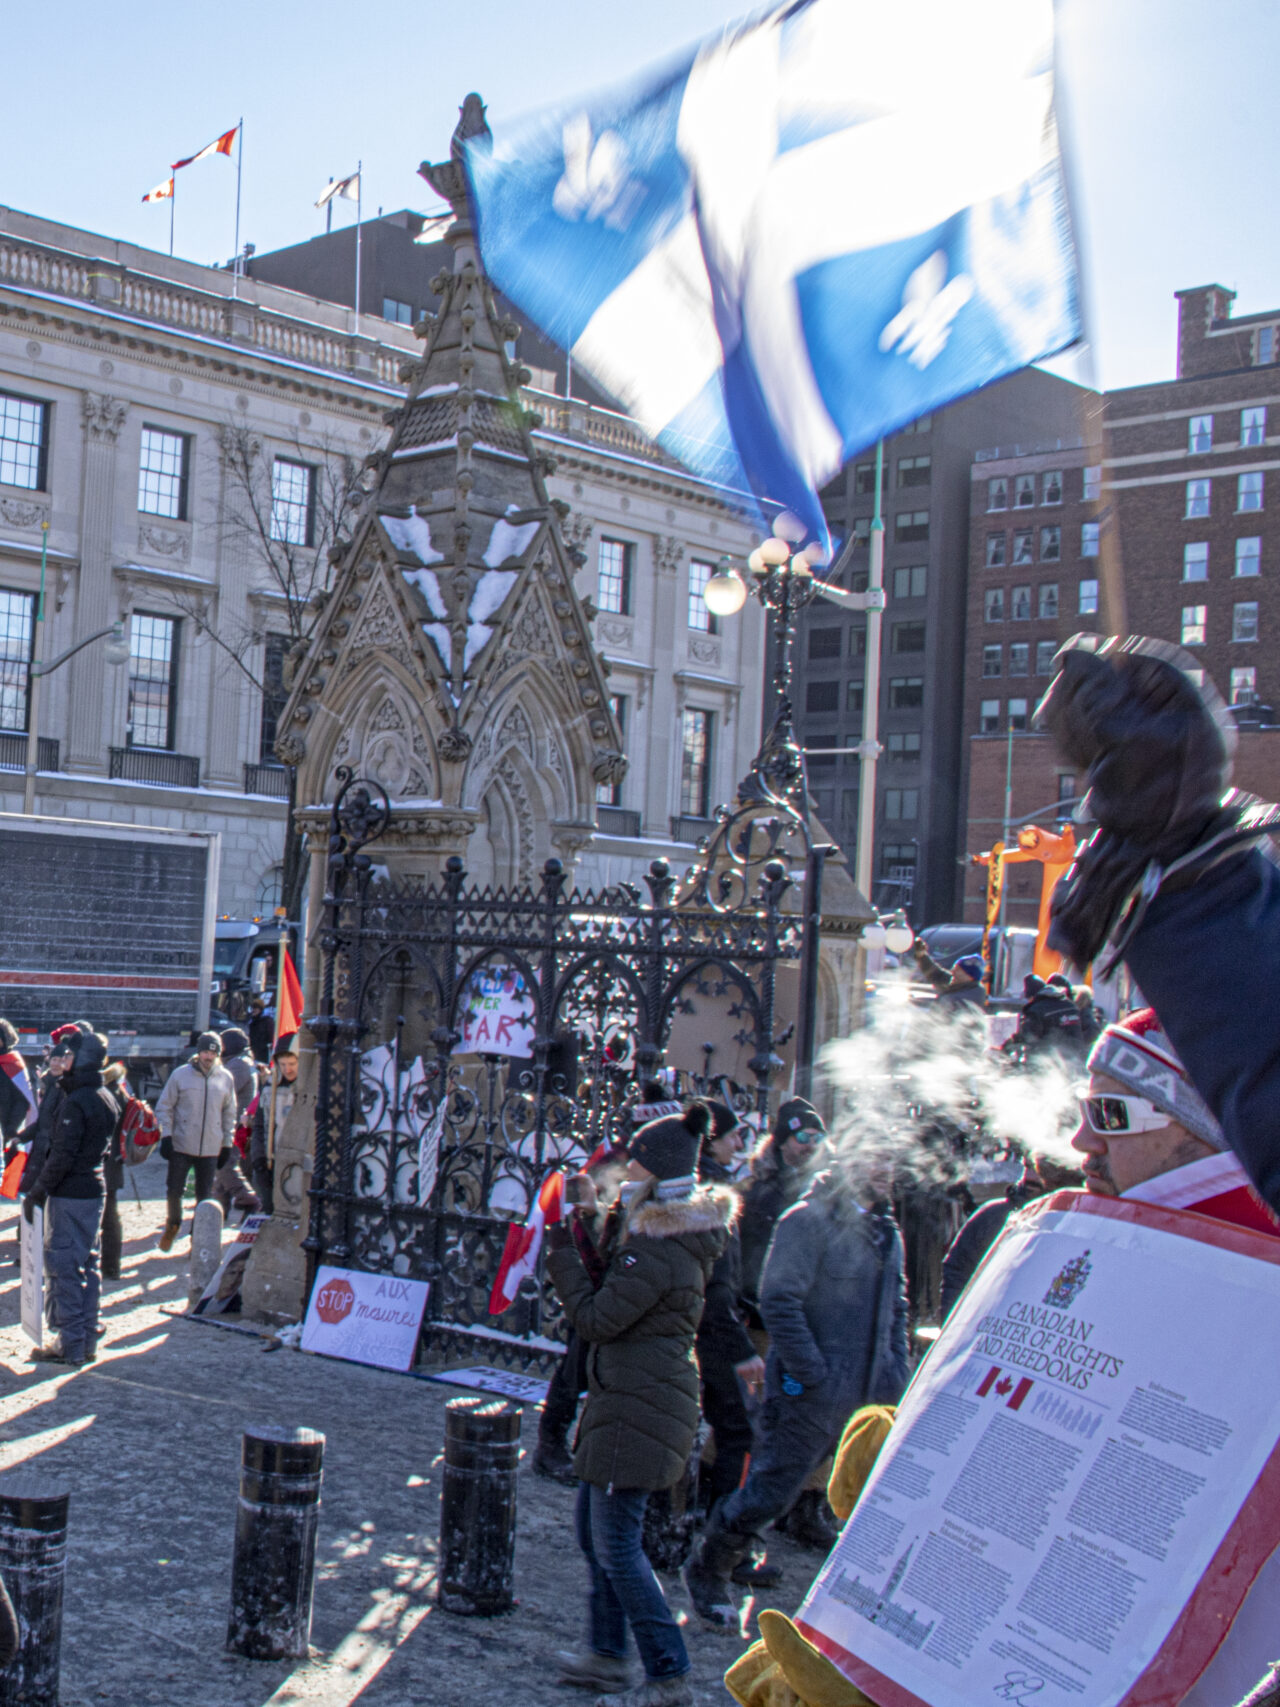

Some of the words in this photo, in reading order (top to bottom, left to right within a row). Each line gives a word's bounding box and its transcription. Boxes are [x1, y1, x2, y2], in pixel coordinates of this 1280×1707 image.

[318, 1289, 353, 1312] STOP
[375, 1280, 412, 1301] AUX
[1007, 1302, 1094, 1342] CANADIAN
[976, 1316, 1031, 1345] CHARTER
[1029, 1330, 1056, 1350] OF
[1052, 1337, 1124, 1378] RIGHTS
[976, 1336, 1003, 1356] AND
[1001, 1343, 1093, 1390] FREEDOMS
